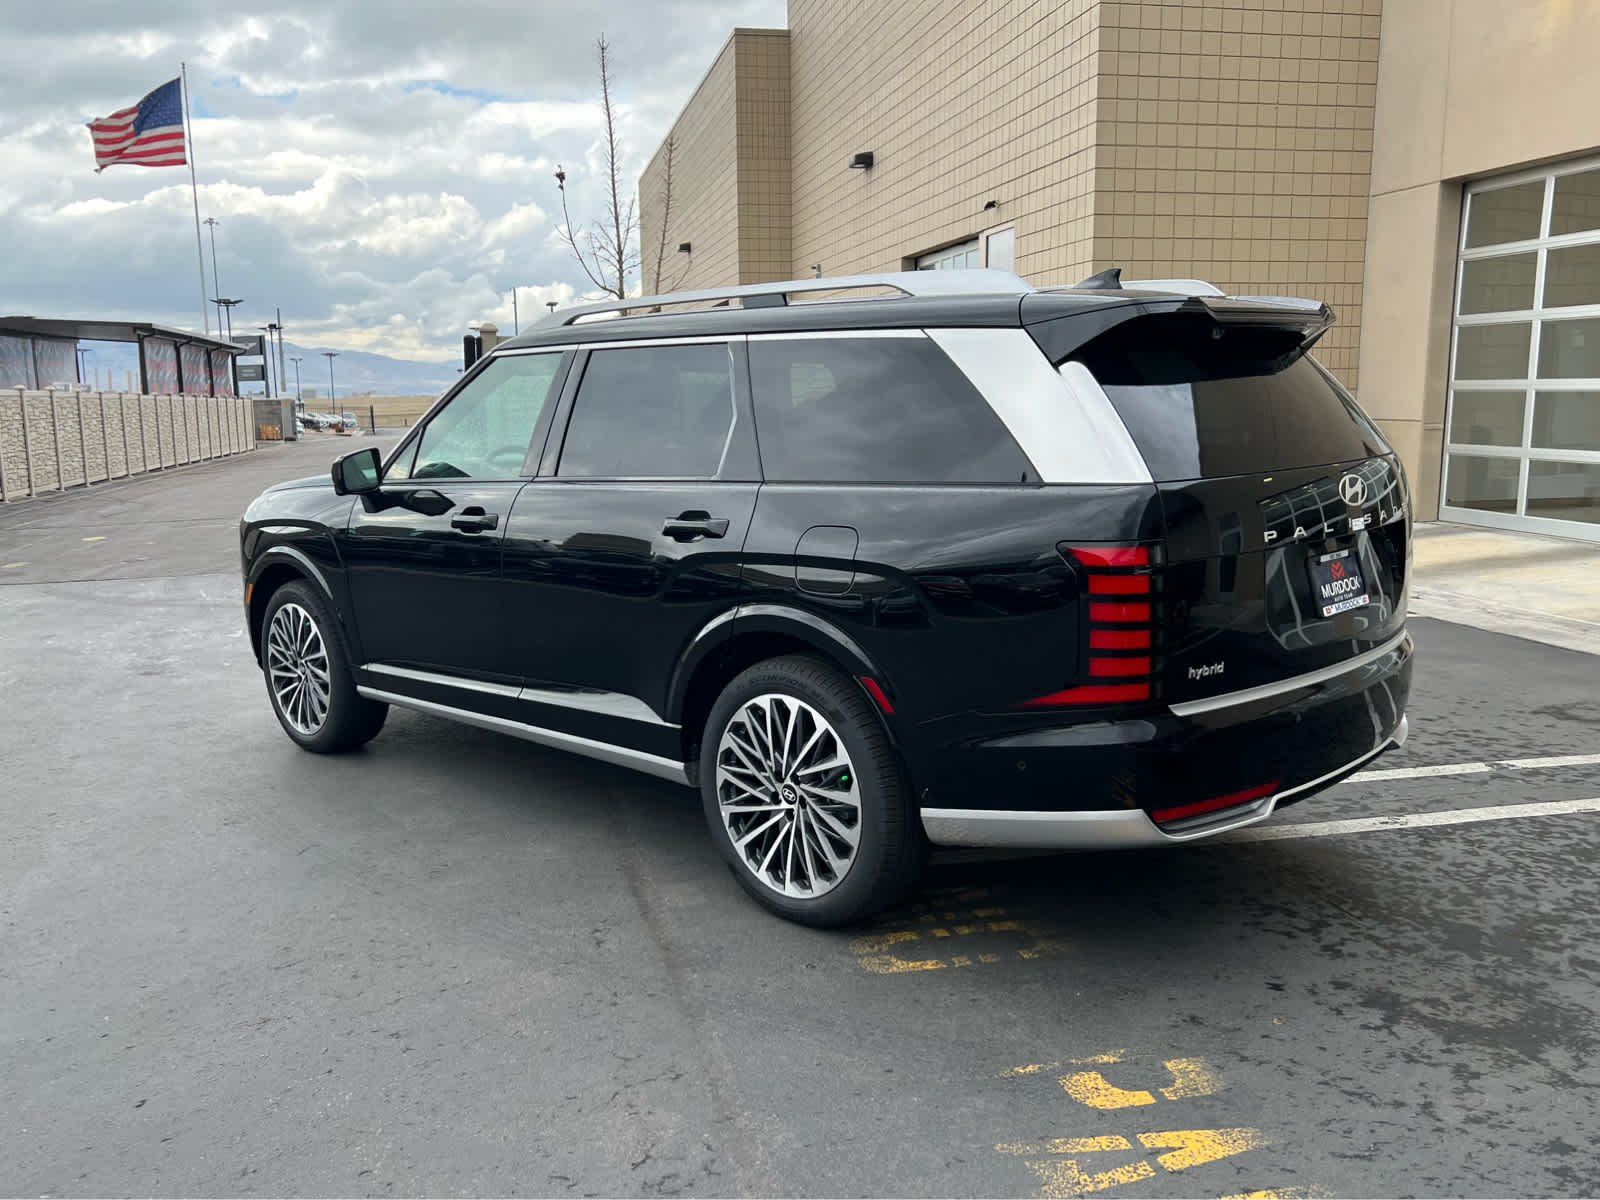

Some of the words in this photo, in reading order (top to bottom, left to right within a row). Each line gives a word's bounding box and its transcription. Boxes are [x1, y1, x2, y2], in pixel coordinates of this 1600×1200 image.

[1263, 502, 1409, 543] PALISADE
[1321, 575, 1361, 599] MURDOCK
[1188, 660, 1225, 680] hybrid
